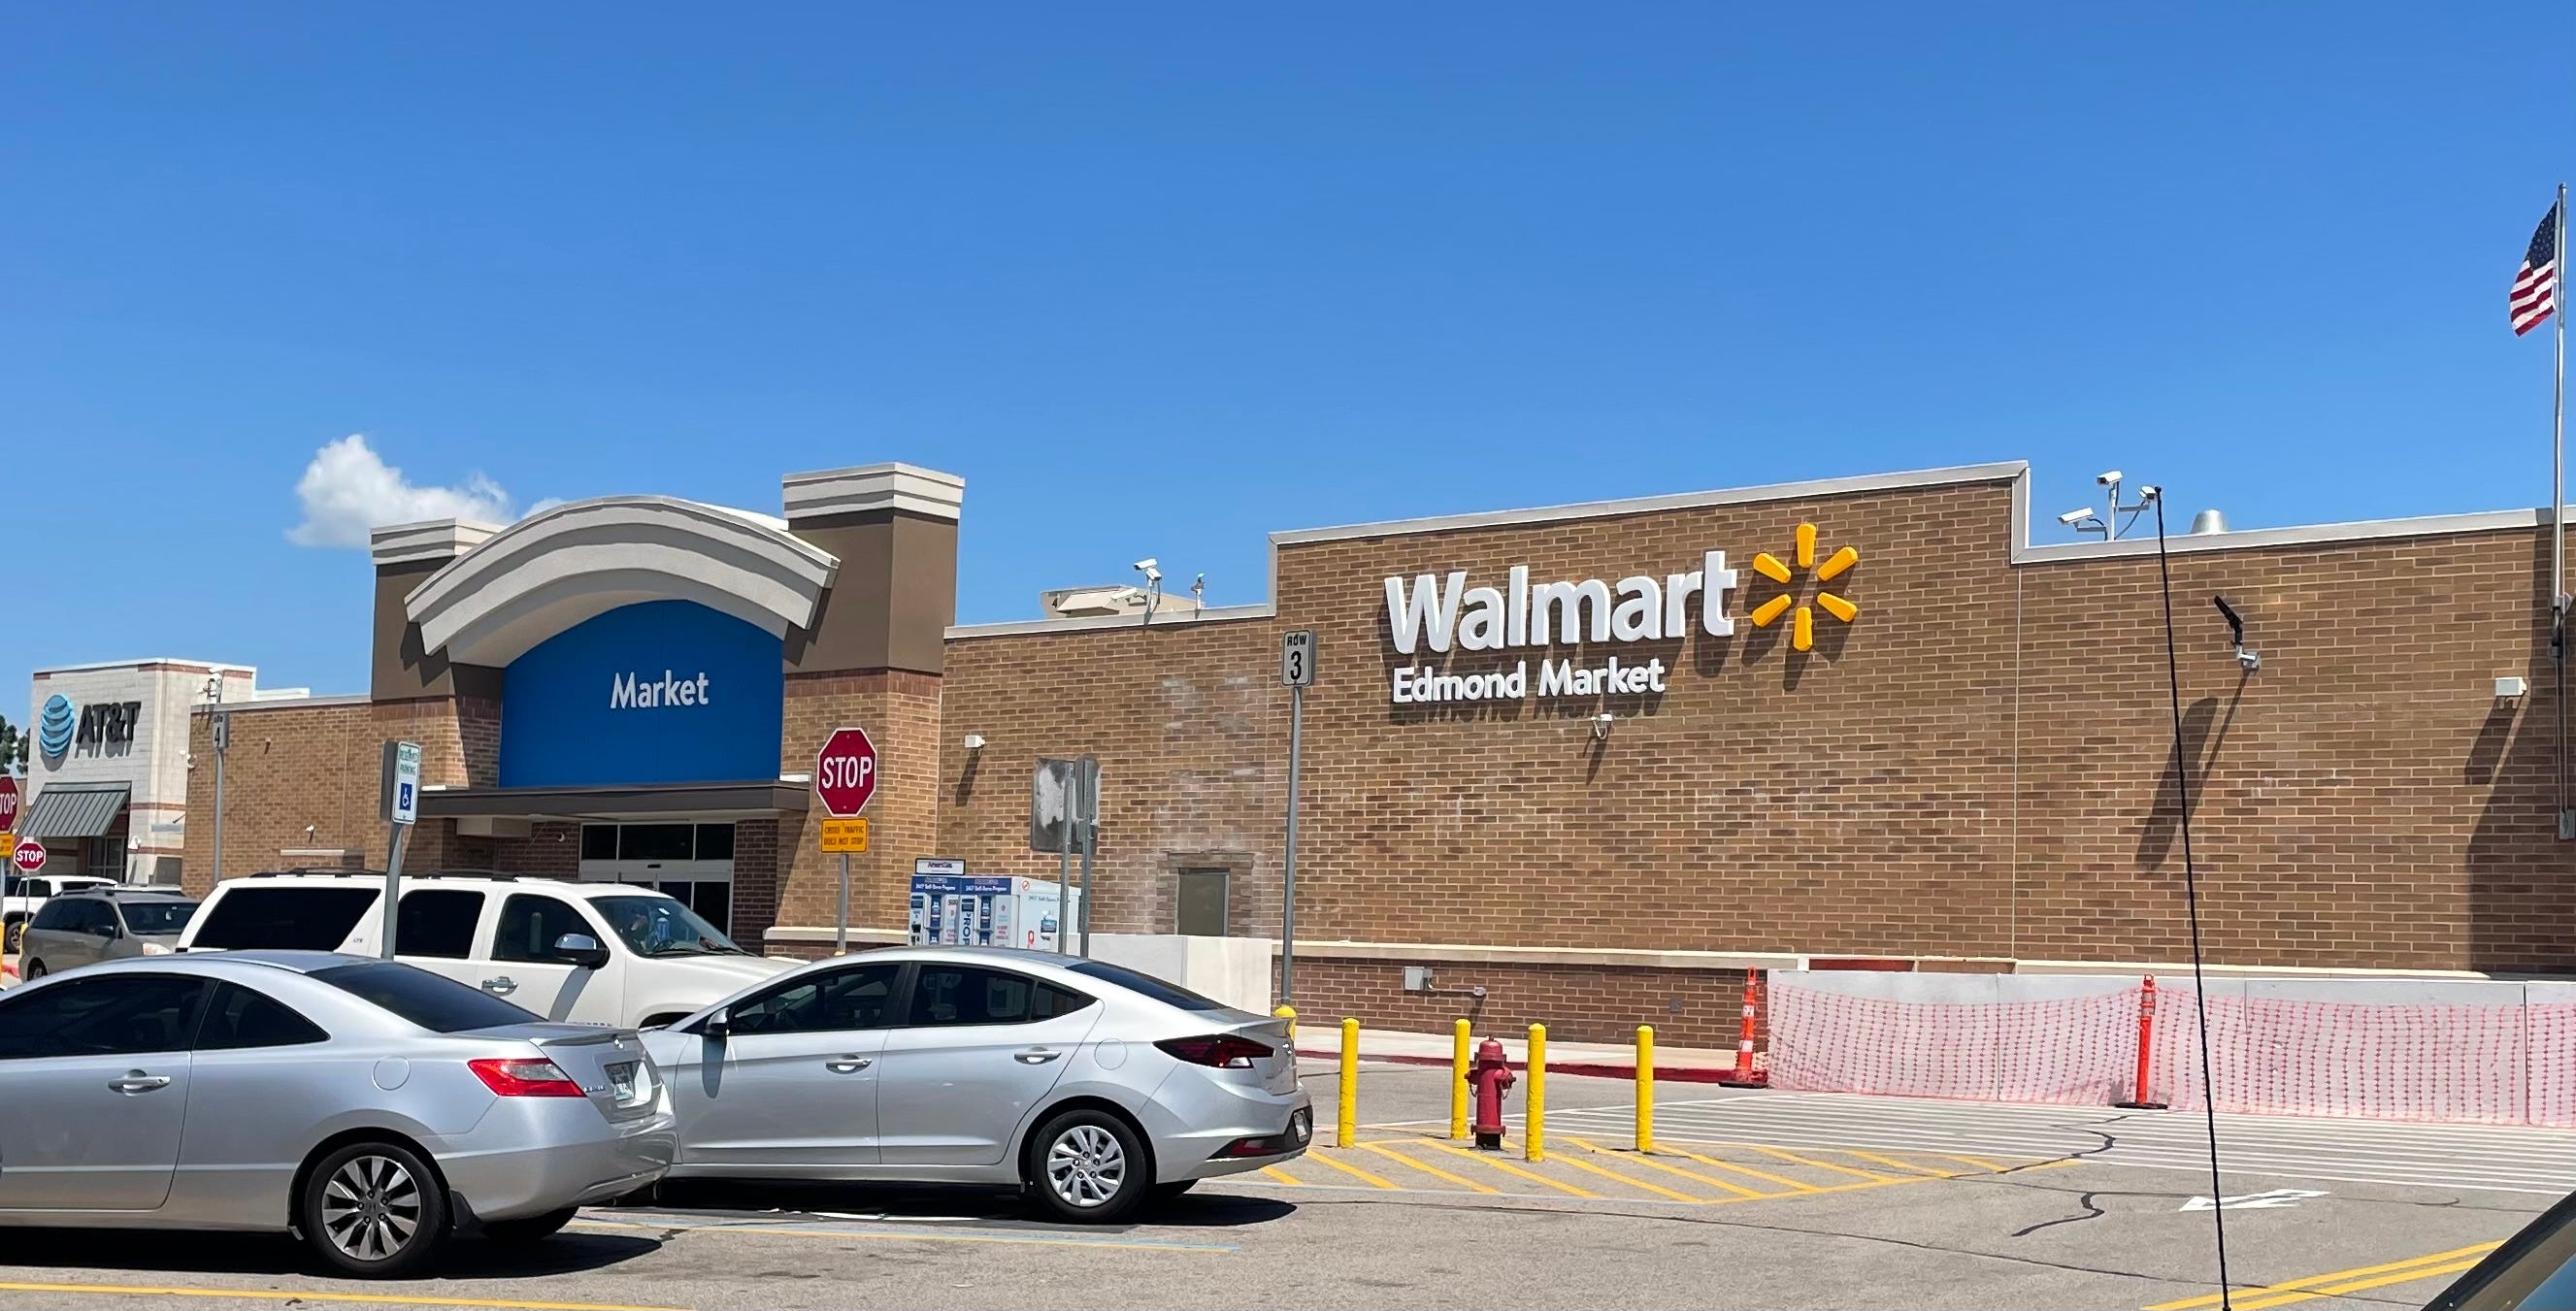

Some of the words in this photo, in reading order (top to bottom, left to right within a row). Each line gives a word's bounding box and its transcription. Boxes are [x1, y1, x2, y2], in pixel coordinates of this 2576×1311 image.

[1384, 550, 1737, 654] Walmart
[1287, 635, 1307, 646] ROW
[1290, 651, 1302, 680] 3
[1393, 660, 1527, 704] Edmond
[1536, 656, 1666, 698] Market
[610, 670, 710, 709] Market
[76, 702, 142, 744] AT&T
[214, 727, 220, 747] 4
[821, 756, 873, 789] STOP
[0, 793, 17, 814] TOP
[16, 849, 44, 863] STOP
